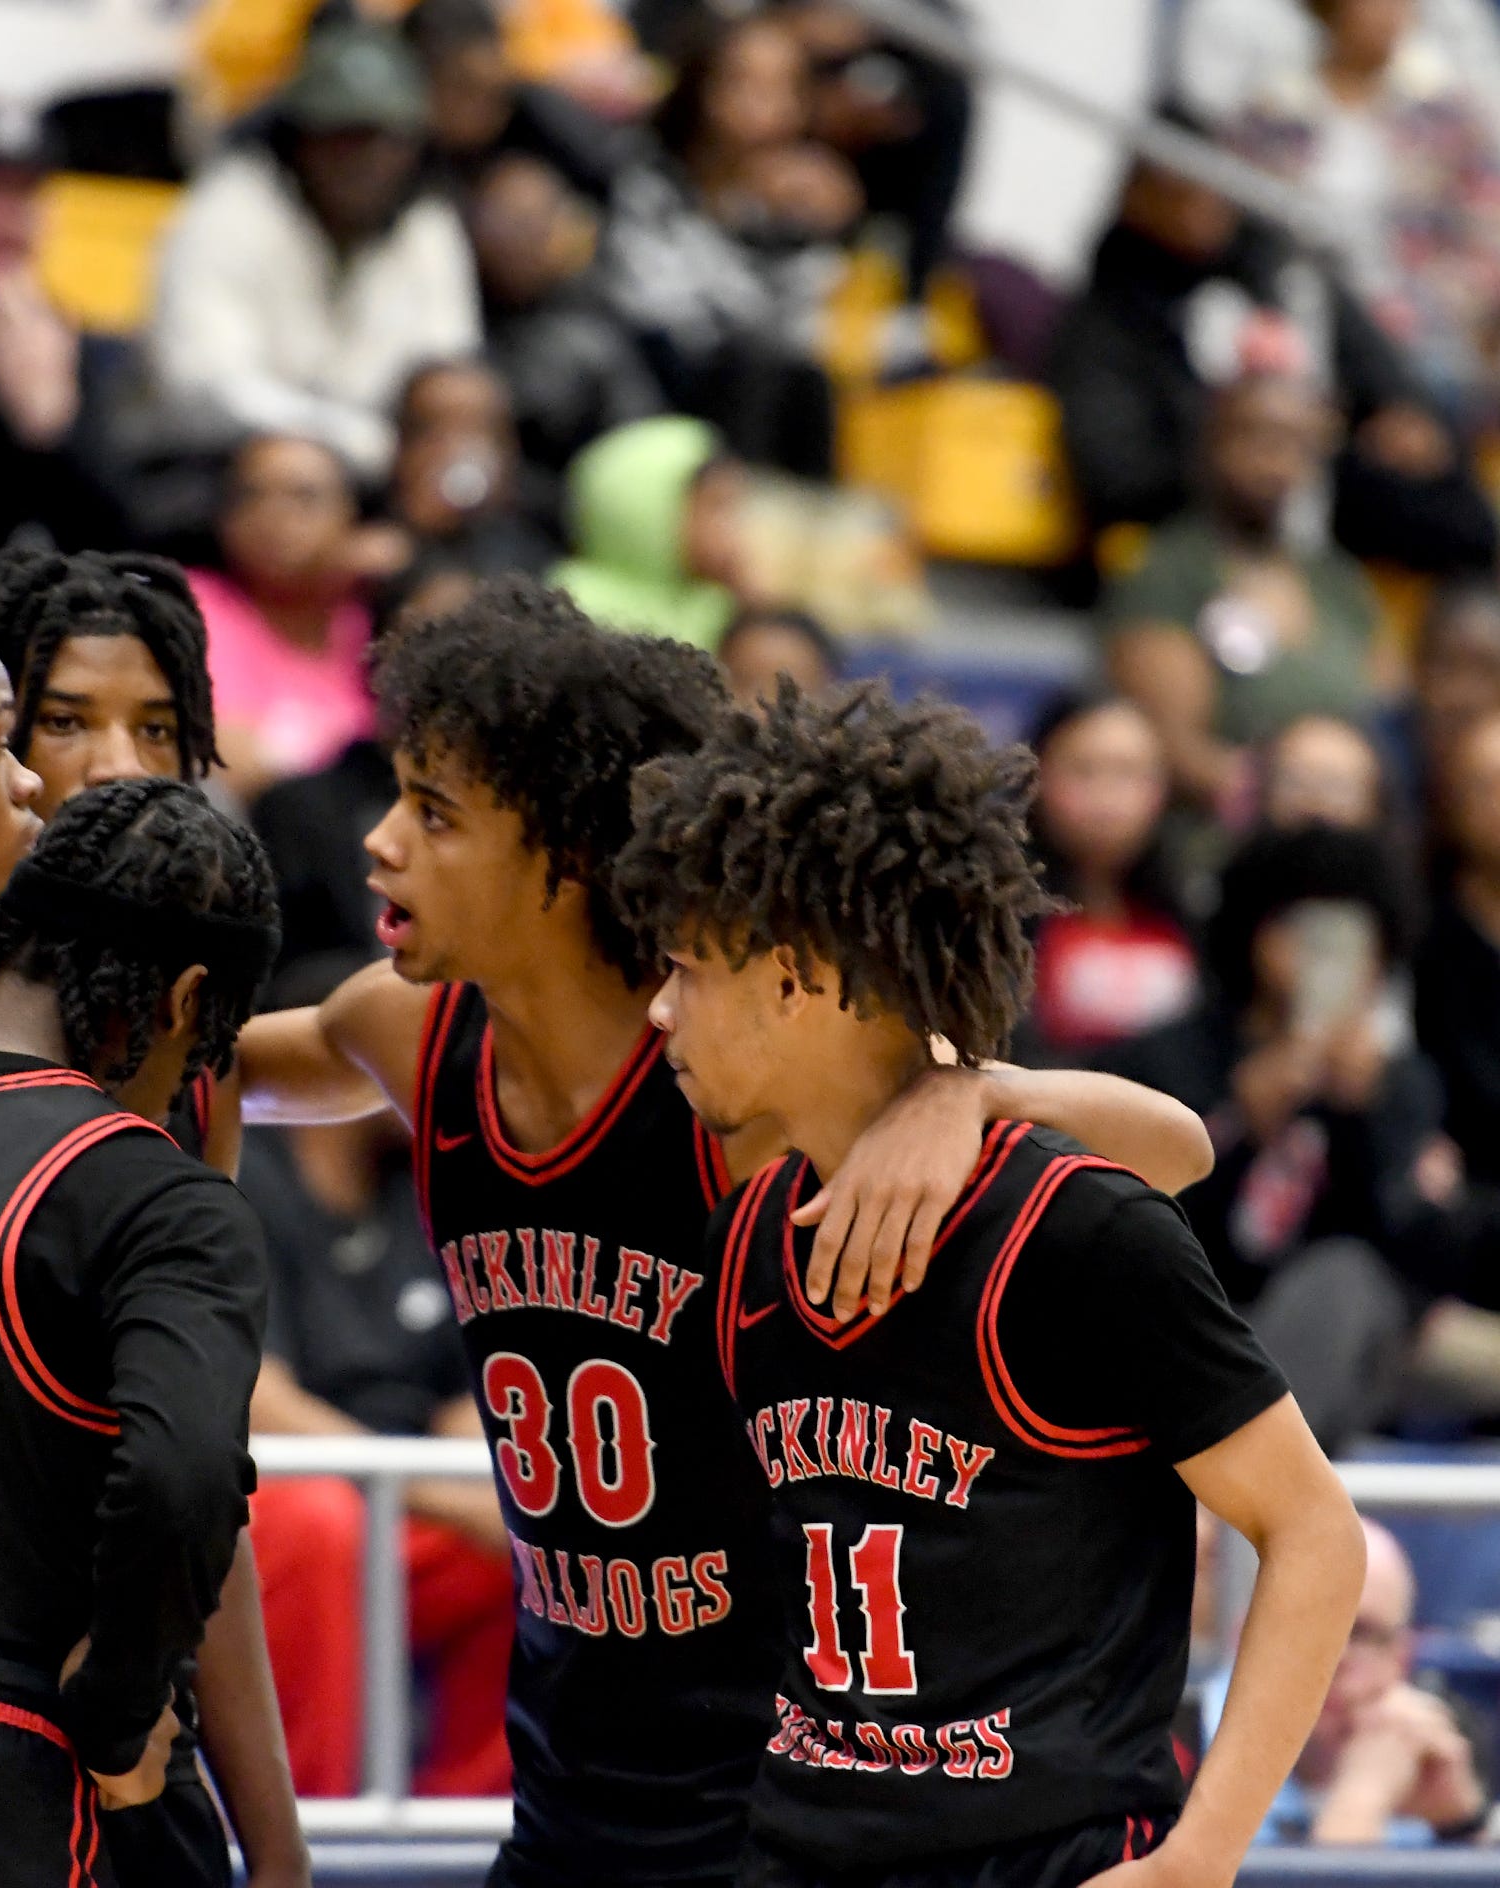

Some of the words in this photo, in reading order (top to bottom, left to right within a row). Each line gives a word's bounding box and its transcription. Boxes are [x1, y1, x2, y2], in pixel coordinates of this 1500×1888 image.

[482, 1351, 658, 1529] 30
[745, 1396, 996, 1510] CKINLEY
[801, 1522, 918, 1696] 11
